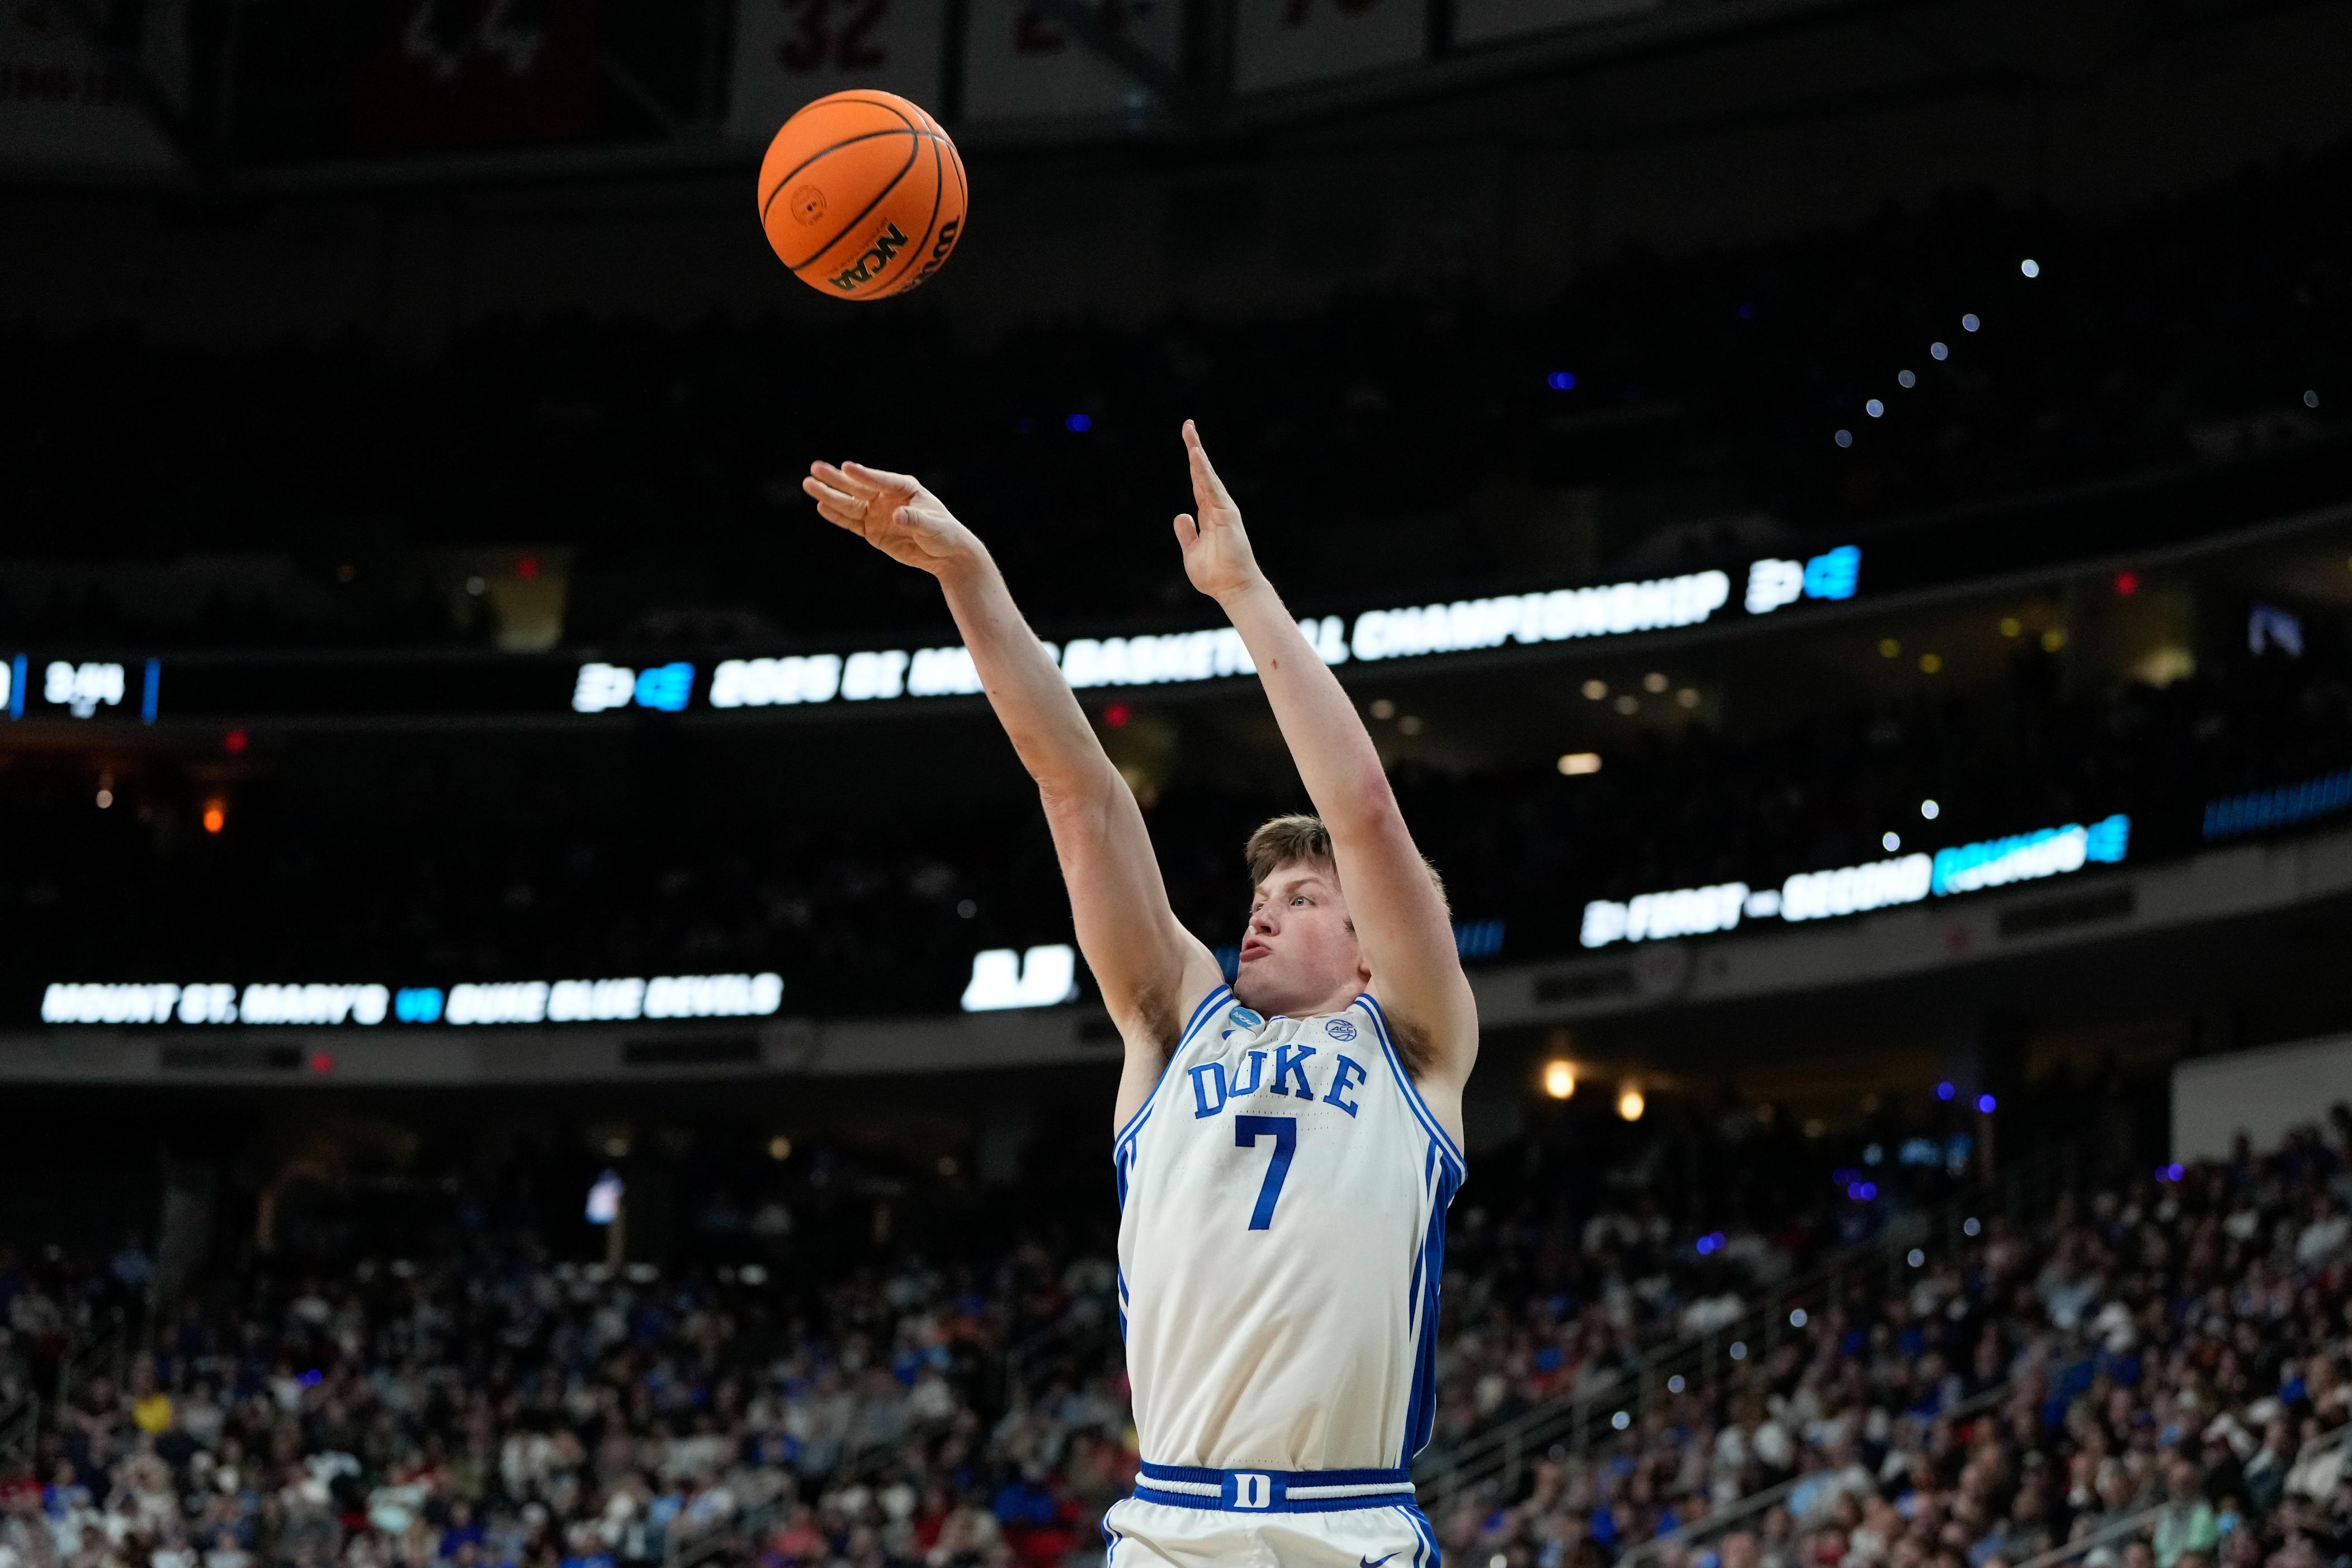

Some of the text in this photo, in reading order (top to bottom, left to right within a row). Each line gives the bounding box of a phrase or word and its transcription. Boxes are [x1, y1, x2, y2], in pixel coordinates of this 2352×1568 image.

[828, 221, 909, 290] NCAA
[1188, 1044, 1367, 1118] DUKE
[1235, 1115, 1297, 1230] 7
[1233, 1473, 1271, 1508] D
